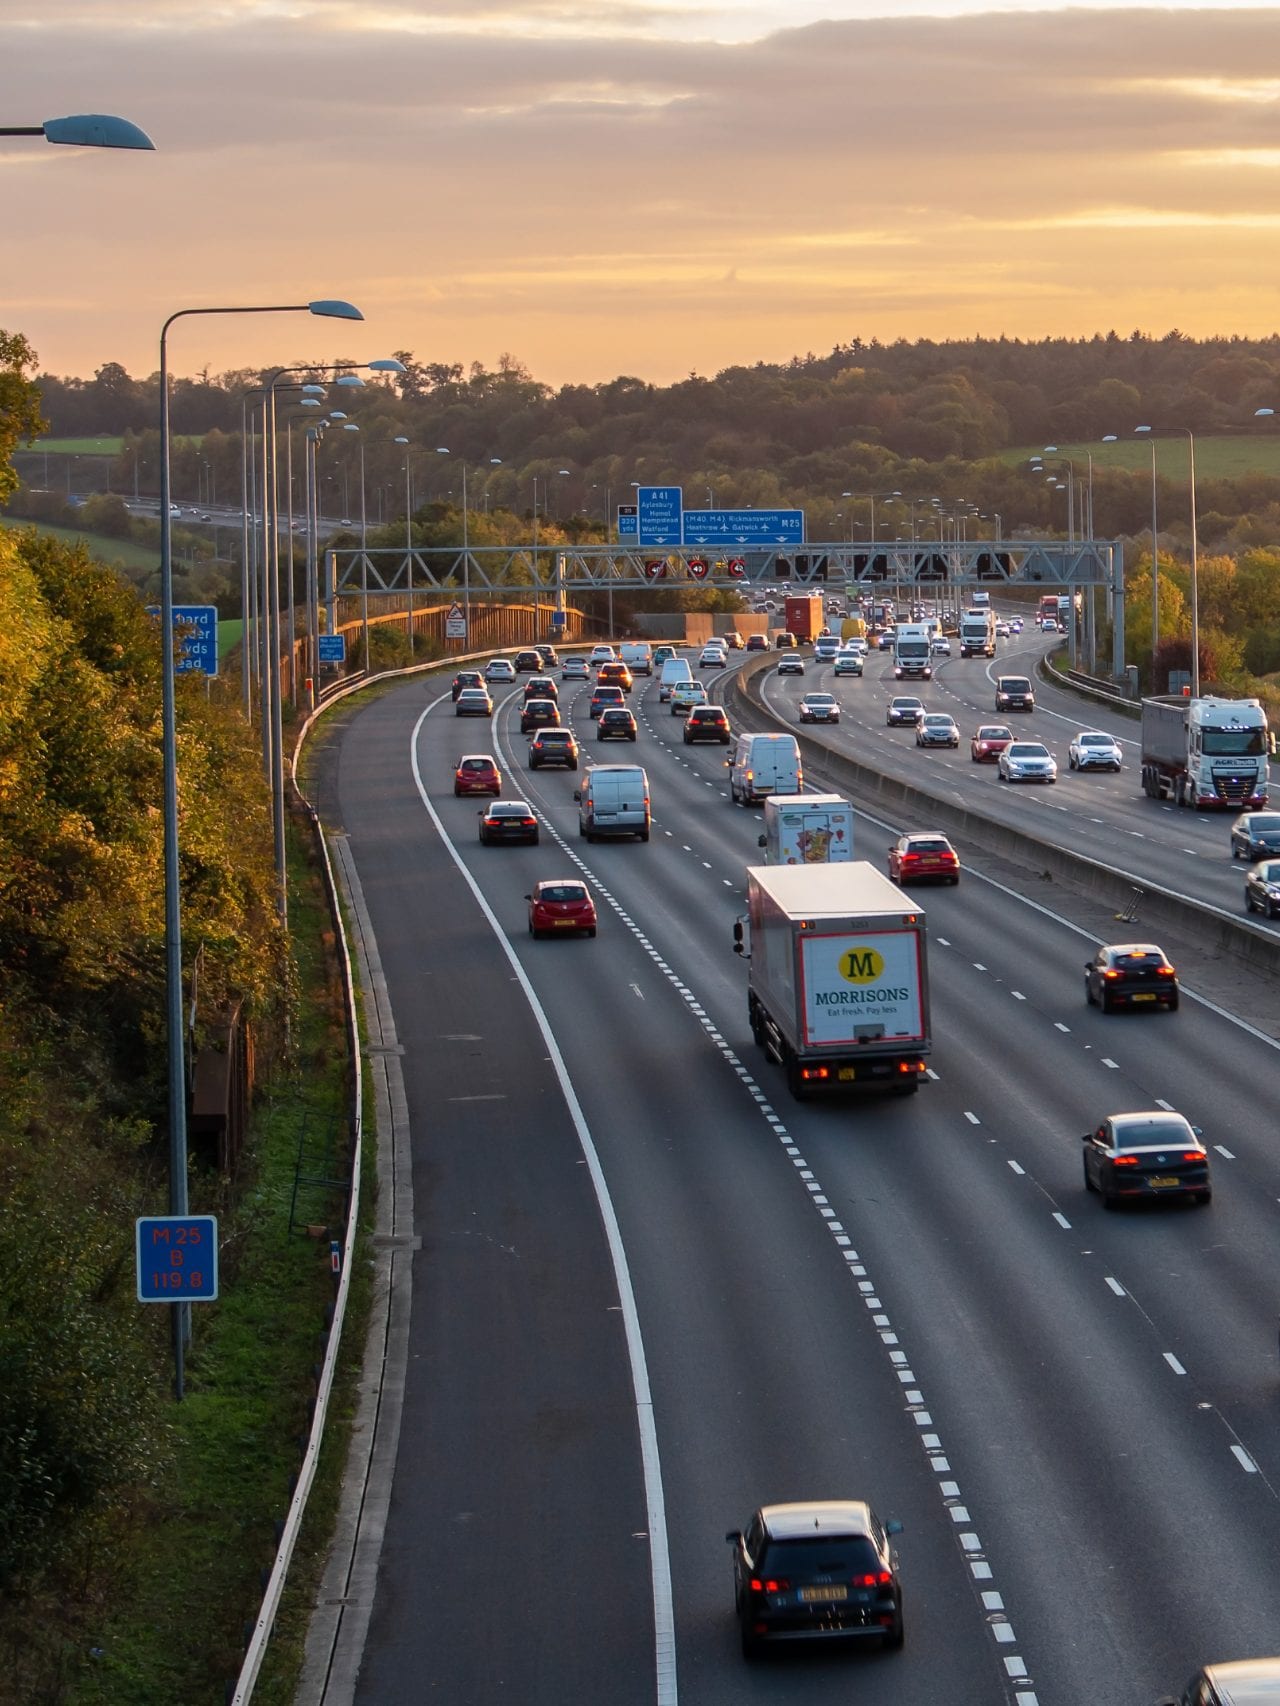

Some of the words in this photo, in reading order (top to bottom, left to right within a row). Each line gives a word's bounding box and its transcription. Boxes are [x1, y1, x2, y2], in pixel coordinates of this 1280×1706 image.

[641, 517, 679, 525] Hempstead
[728, 514, 779, 523] Rickmansworth
[781, 519, 800, 528] M25
[732, 523, 759, 531] Gatwick
[848, 952, 876, 977] M
[815, 988, 909, 1006] MORRISONS
[827, 1008, 841, 1017] Eat
[866, 1005, 880, 1016] Pay
[882, 1005, 897, 1014] less
[171, 1250, 184, 1267] B
